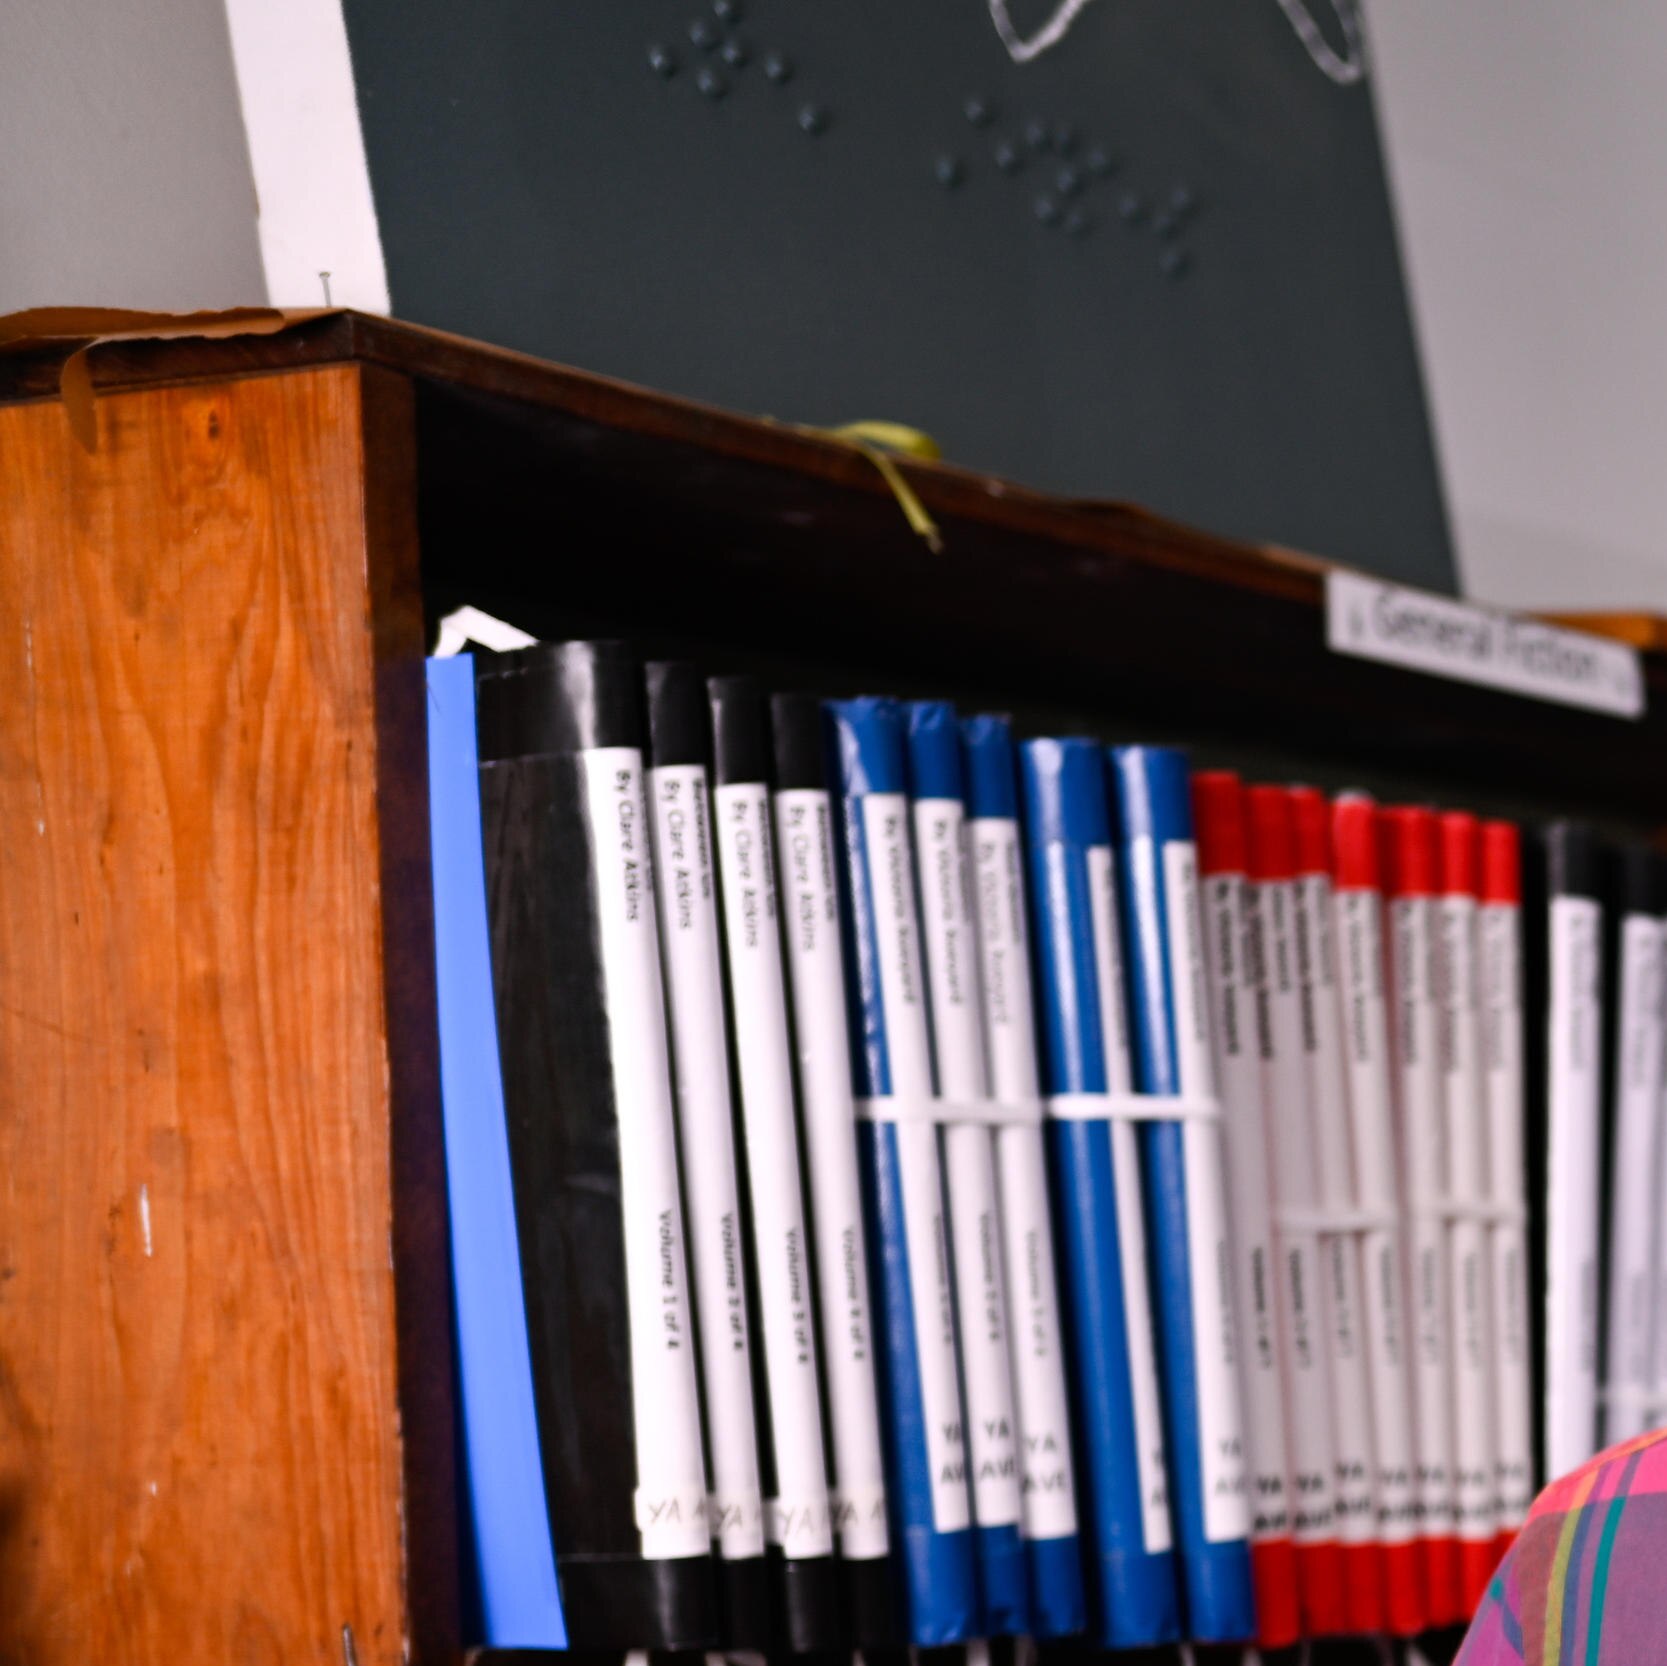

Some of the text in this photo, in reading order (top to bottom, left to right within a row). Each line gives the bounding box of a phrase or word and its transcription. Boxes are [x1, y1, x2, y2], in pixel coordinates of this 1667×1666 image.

[615, 768, 639, 922] By Clare Atkins
[663, 779, 691, 930] By Clare Atkins
[735, 829, 753, 879] Clare
[793, 834, 809, 883] Clare
[741, 886, 759, 948] Atkins
[659, 1208, 674, 1287] Volume
[721, 1210, 737, 1289] Volume
[664, 1311, 680, 1333] of
